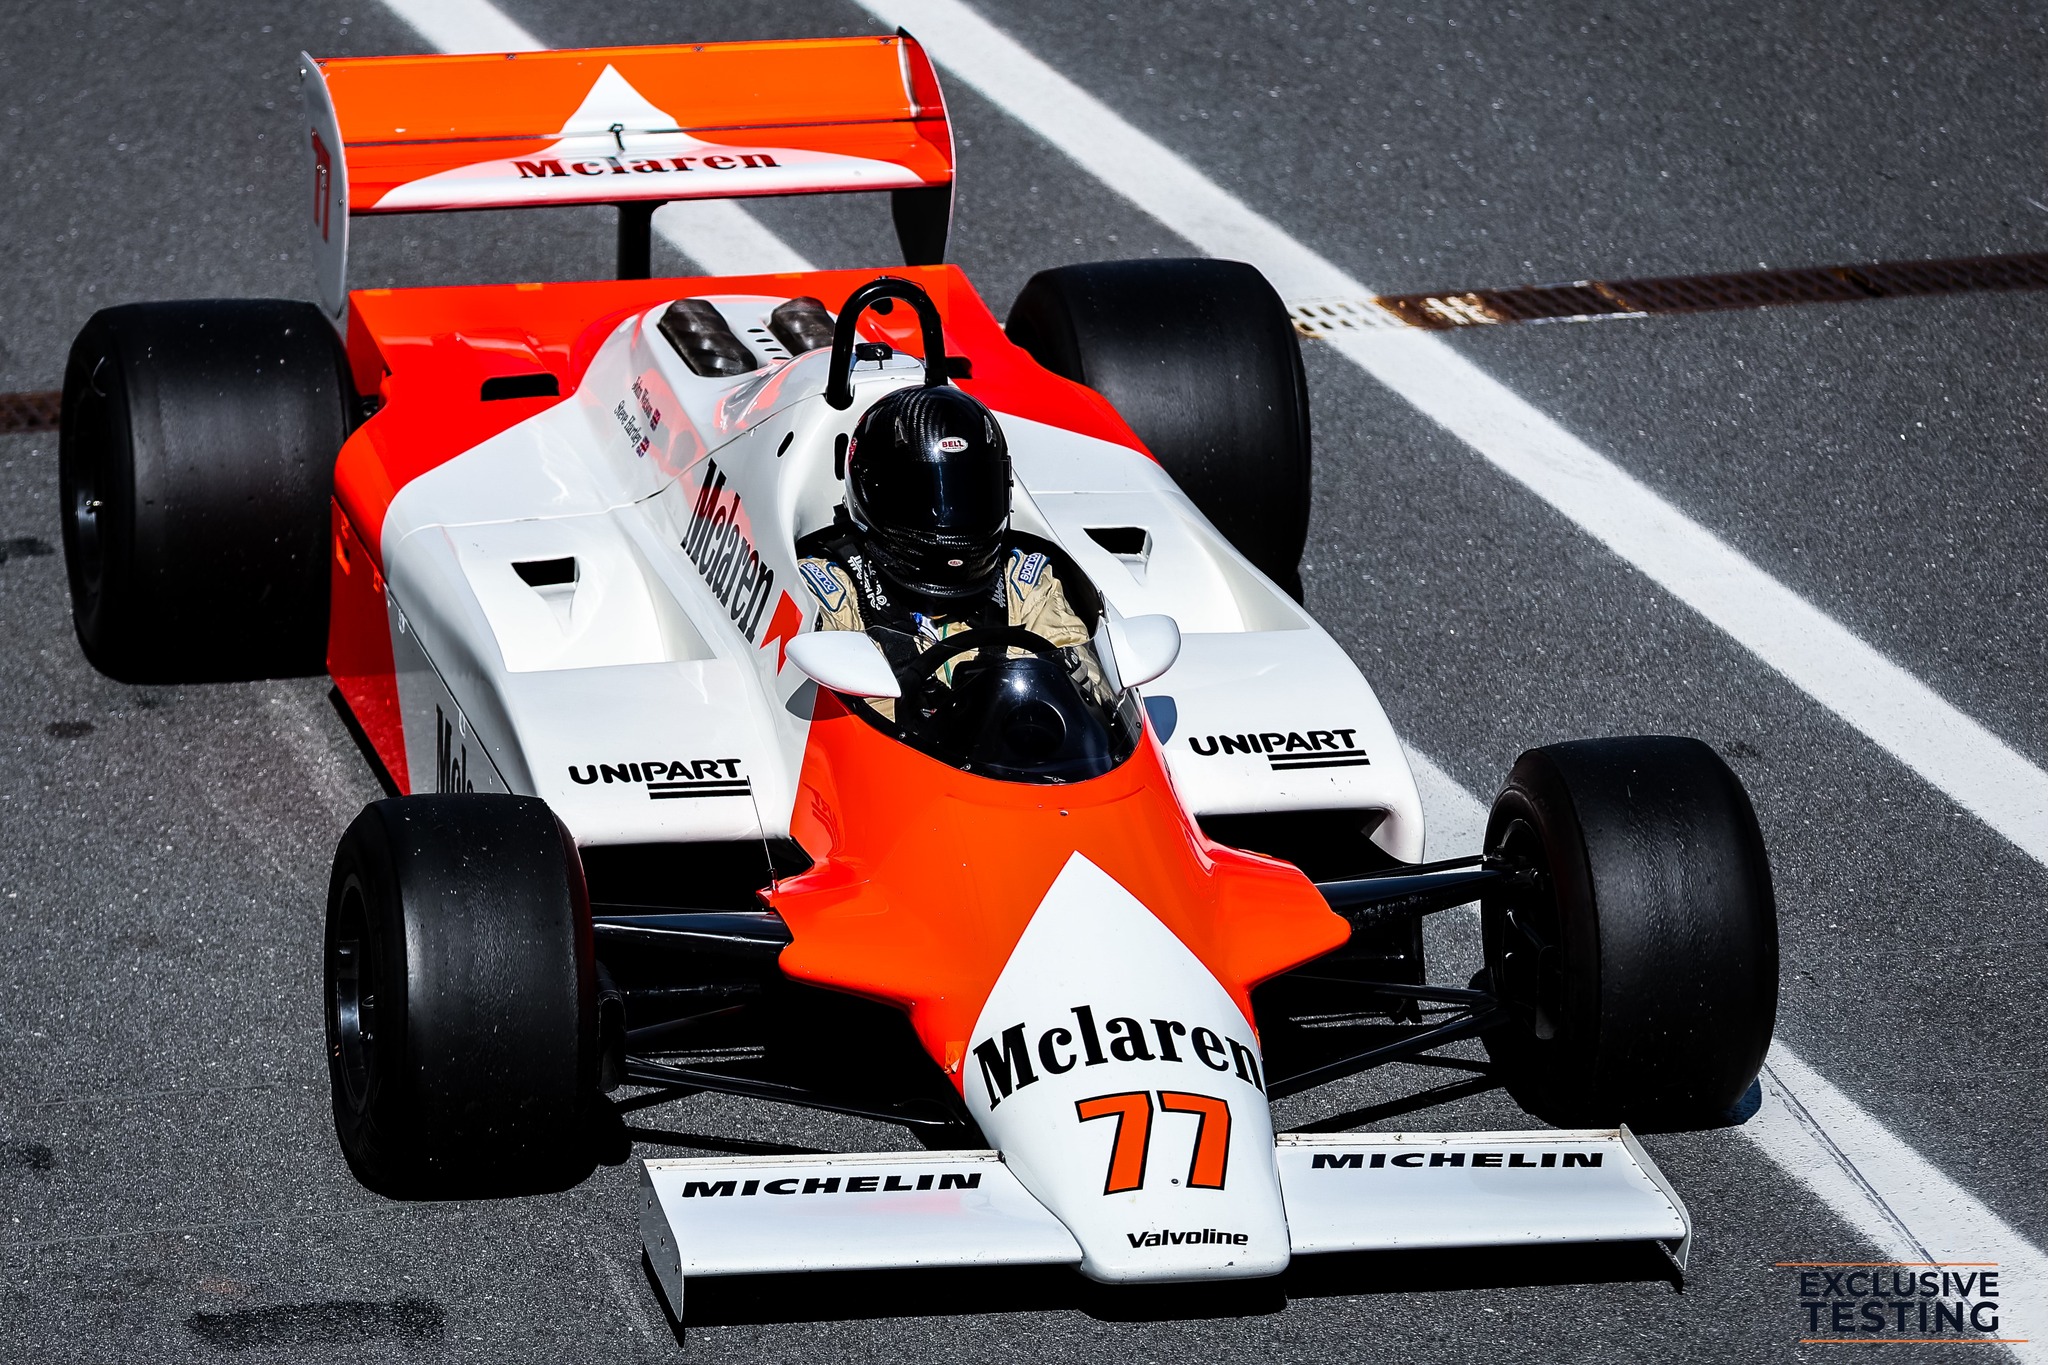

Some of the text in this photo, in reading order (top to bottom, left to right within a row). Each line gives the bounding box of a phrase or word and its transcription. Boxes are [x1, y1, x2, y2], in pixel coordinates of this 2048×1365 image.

[511, 153, 782, 179] Mclaren
[614, 400, 642, 448] Steve Hartley
[942, 440, 964, 448] BELL
[680, 457, 775, 644] Mclaren
[805, 562, 836, 591] sparco
[1188, 729, 1357, 756] UNIPART
[568, 758, 742, 785] UNIPART
[972, 1004, 1267, 1112] Mclaren
[1074, 1090, 1232, 1196] 77
[1311, 1151, 1604, 1169] MICHELIN
[681, 1173, 982, 1198] MICHELIN
[1127, 1228, 1249, 1249] Valvoline
